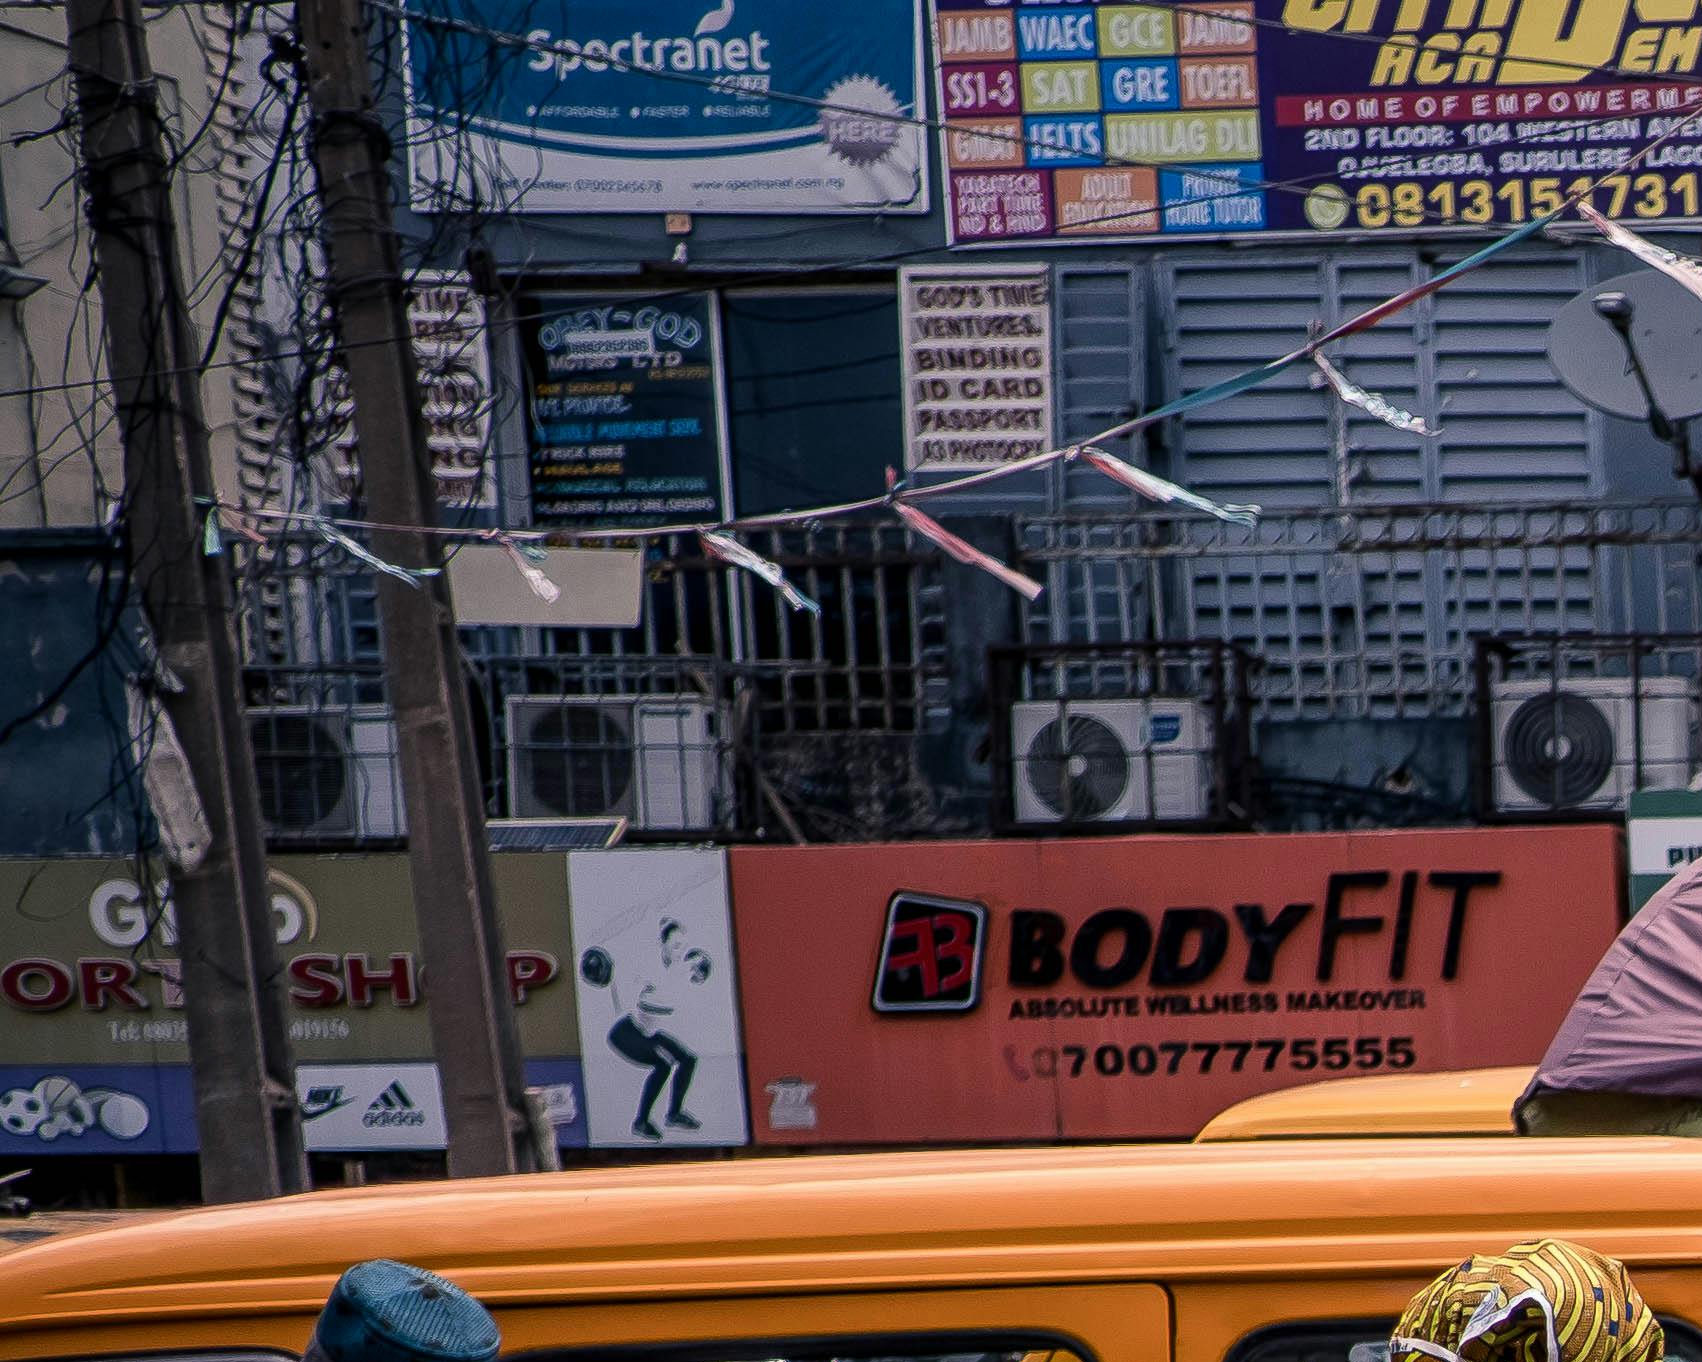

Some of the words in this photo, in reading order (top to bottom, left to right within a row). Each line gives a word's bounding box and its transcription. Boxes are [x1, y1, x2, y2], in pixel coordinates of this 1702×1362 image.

[943, 15, 1013, 54] JAMB
[1018, 15, 1094, 51] WAEC
[1108, 12, 1166, 49] GCE
[527, 29, 771, 80] Spectranet
[947, 69, 1015, 109] SS1-3
[1031, 69, 1090, 105] SAT
[1112, 66, 1169, 103] GRE
[1183, 63, 1256, 101] TOEFL
[641, 104, 690, 118] FASTER
[713, 103, 771, 118] RELIABLE
[1303, 96, 1404, 122] HOME
[1415, 95, 1459, 117] OF
[829, 119, 900, 146] HERE
[1029, 121, 1100, 161] IELTS
[1109, 119, 1208, 157] UNILAG
[1304, 128, 1361, 151] 2ND
[1365, 125, 1455, 149] FLOOR:
[987, 283, 1047, 308] TIME
[538, 306, 702, 350] OBEY-GOD
[915, 347, 1043, 371] BINDING
[919, 378, 949, 402] ID
[959, 378, 1044, 399] CARD
[918, 408, 1044, 431] PASSPORT
[1007, 871, 1503, 990] BODYFIT
[289, 951, 562, 1009] SHP
[1008, 998, 1139, 1020] ABSOLUTE
[1146, 993, 1279, 1016] WELLNESS
[1286, 987, 1427, 1012] MAKEOVER
